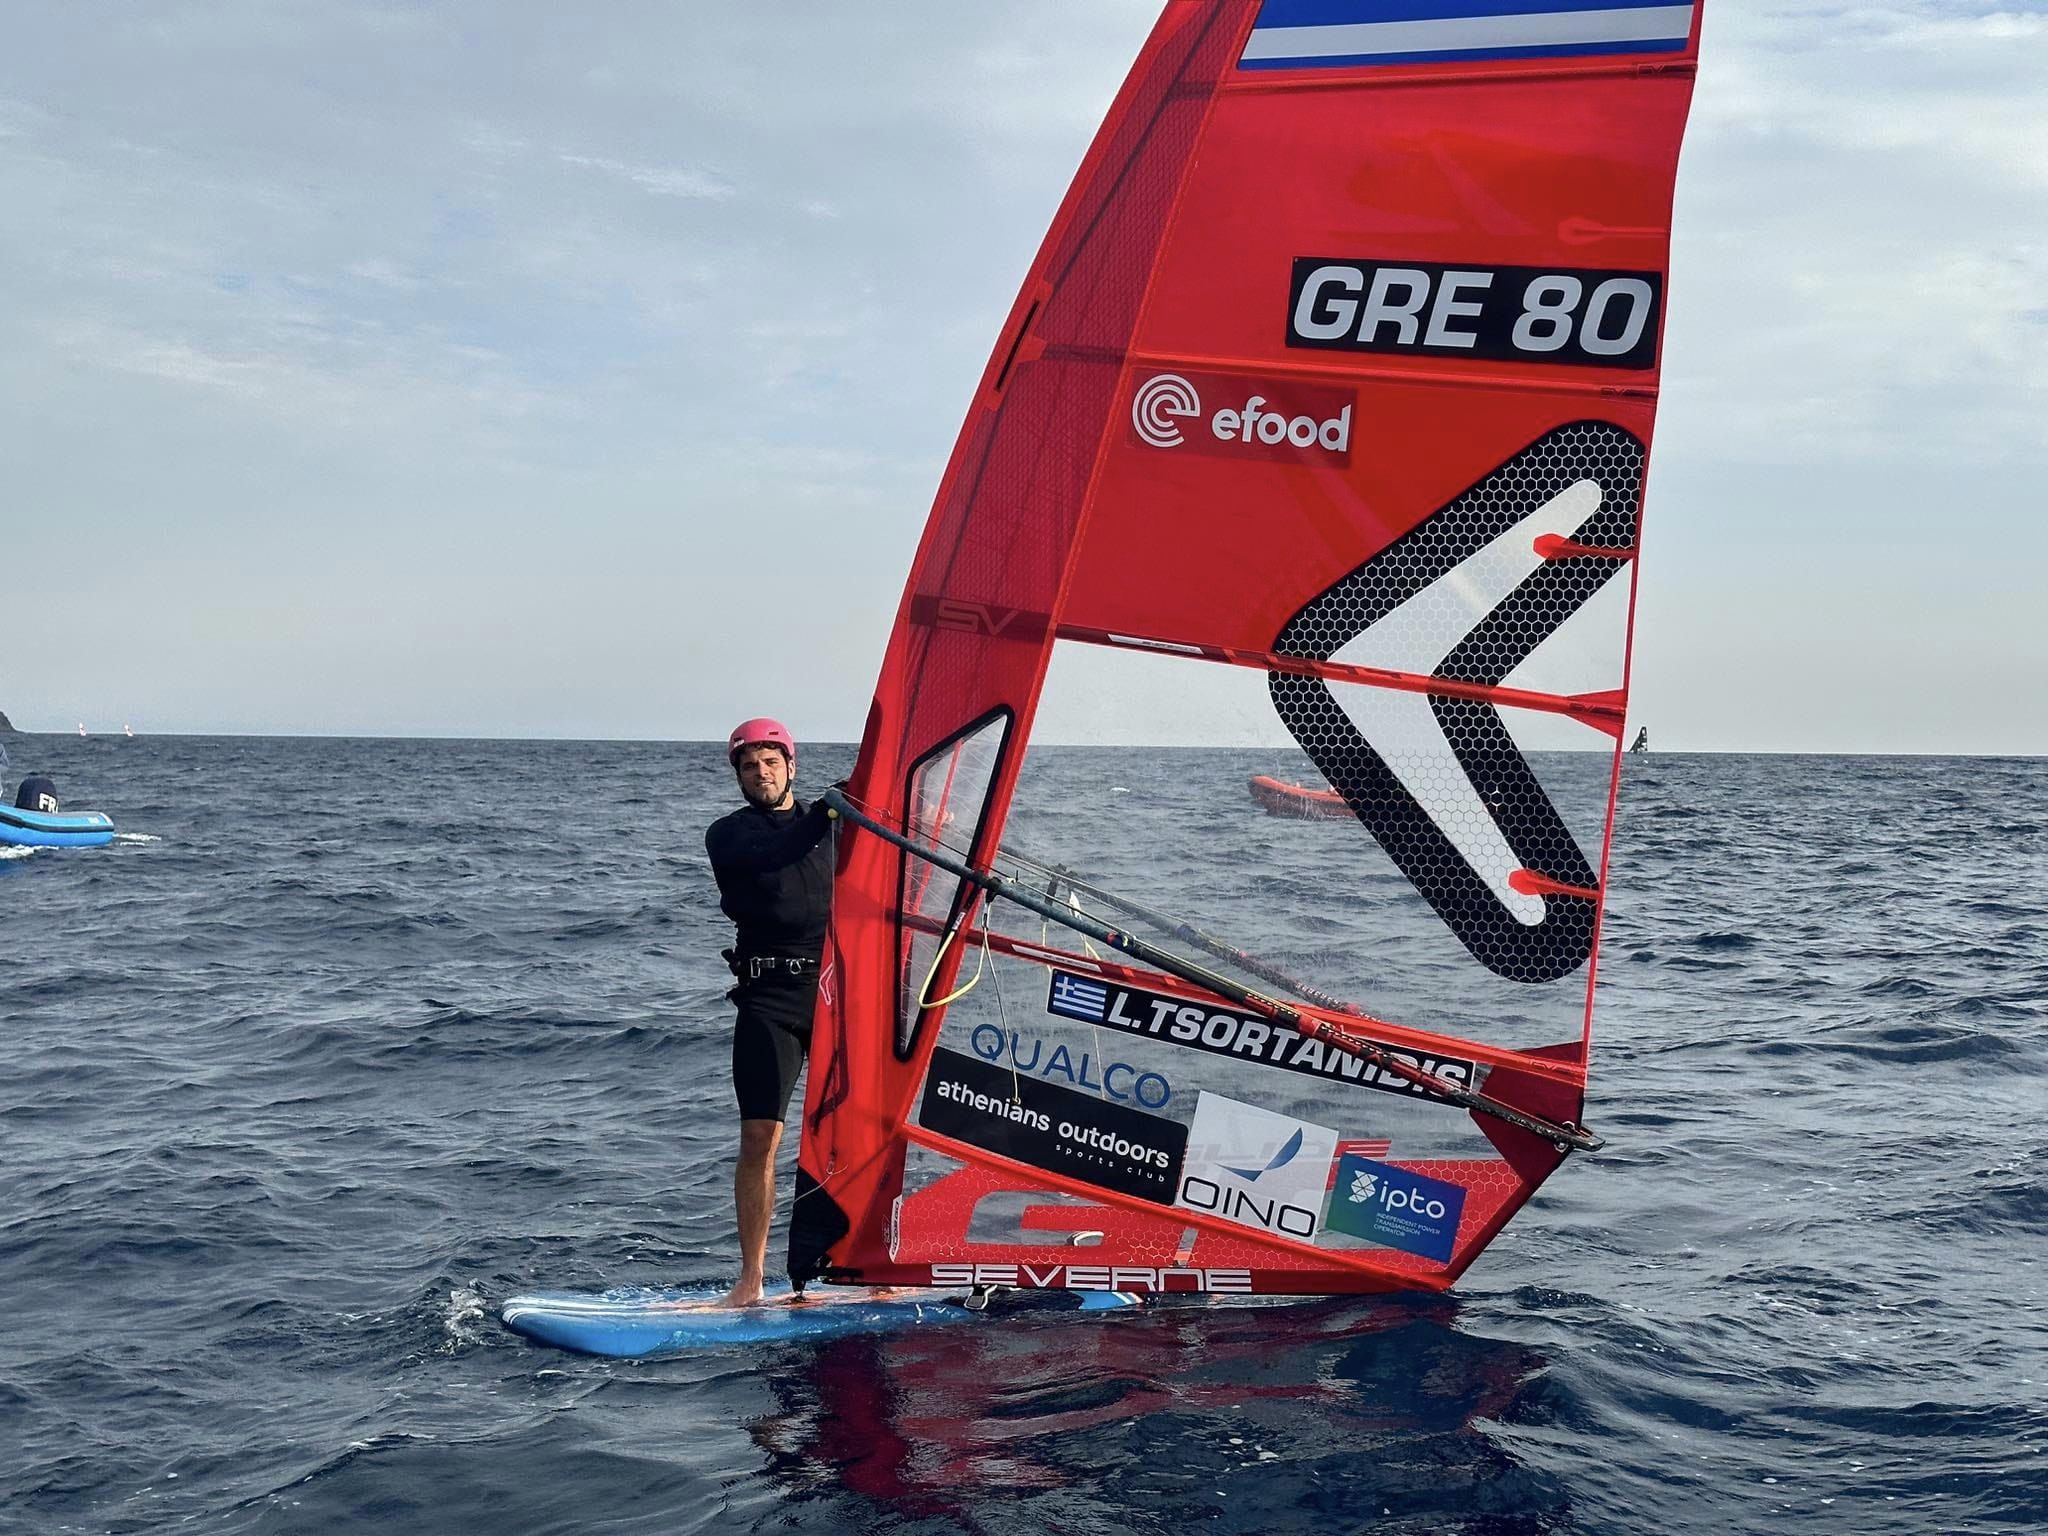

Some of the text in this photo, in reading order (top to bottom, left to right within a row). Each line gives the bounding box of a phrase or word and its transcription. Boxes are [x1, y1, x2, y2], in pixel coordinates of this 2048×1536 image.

[1293, 265, 1653, 356] GRE 80
[1211, 396, 1352, 453] efood
[970, 1023, 1171, 1109] QUALCO
[937, 1080, 1051, 1132] athenians
[1057, 1121, 1170, 1169] outdoors
[1055, 1143, 1166, 1183] sports club
[1181, 1175, 1317, 1238] OINO
[1379, 1180, 1446, 1219] ipto
[931, 1263, 1252, 1293] SEVERNE
